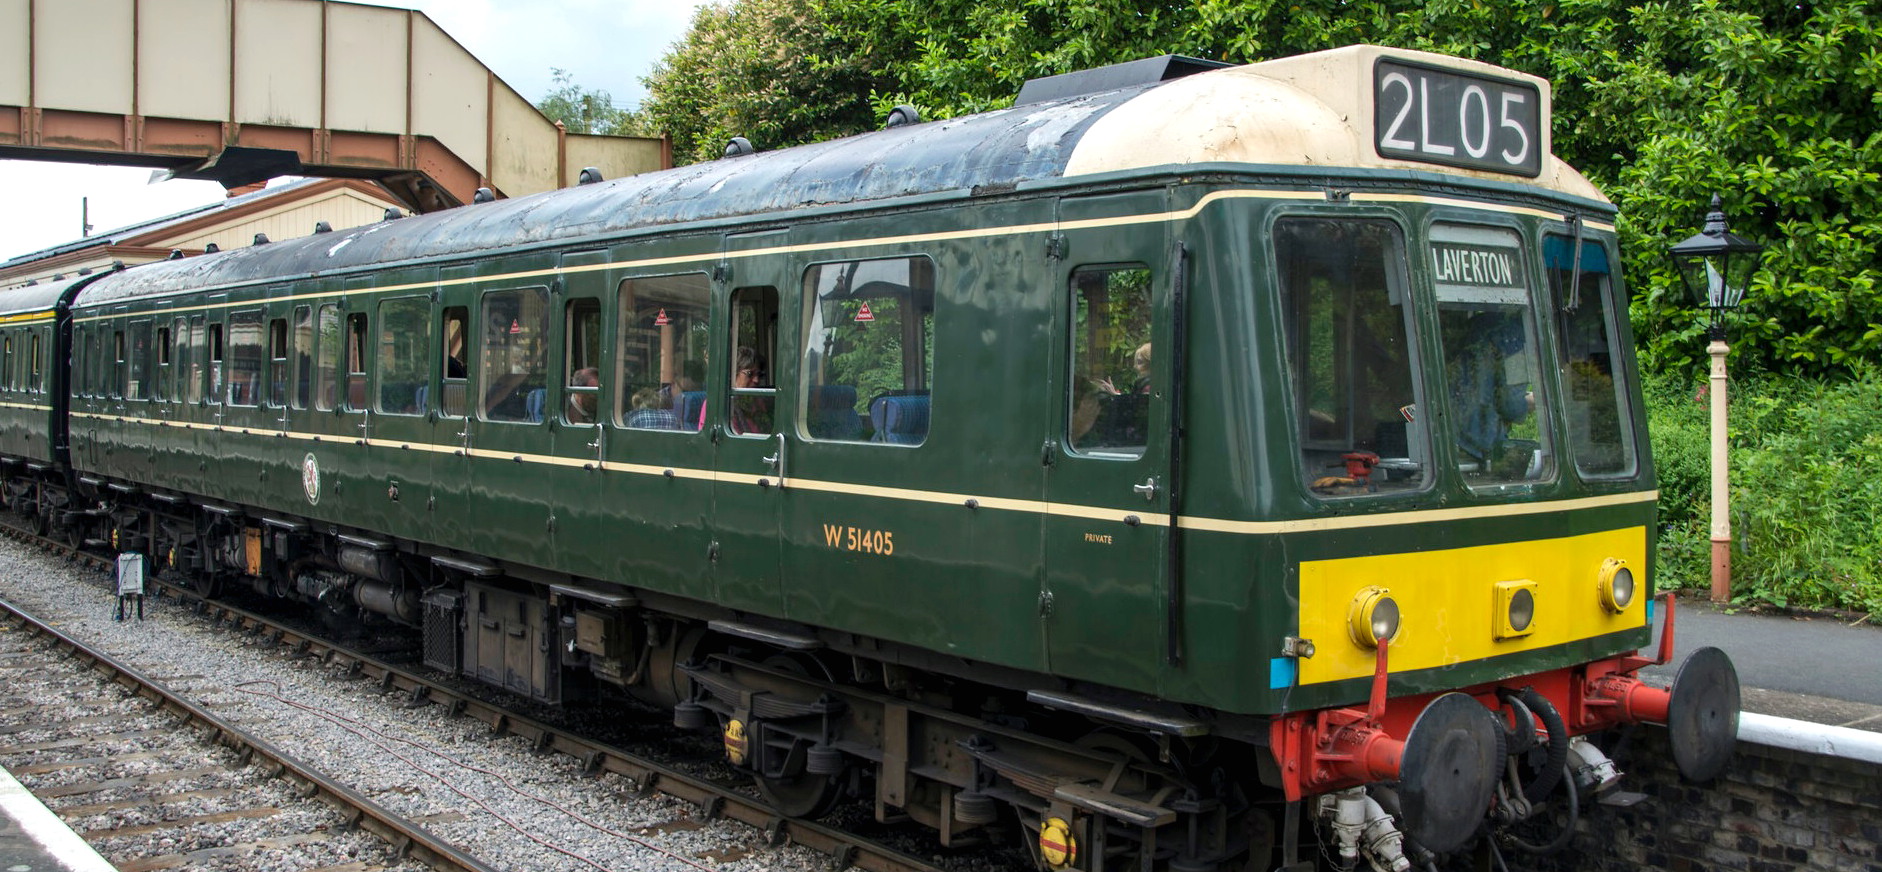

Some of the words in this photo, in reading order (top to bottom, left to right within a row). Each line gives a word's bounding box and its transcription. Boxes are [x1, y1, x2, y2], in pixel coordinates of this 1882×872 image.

[1381, 72, 1528, 165] 2L05
[1432, 248, 1513, 285] LAVERTON
[823, 523, 843, 548] W
[848, 526, 894, 556] 51405
[1085, 533, 1113, 544] PRIVATE
